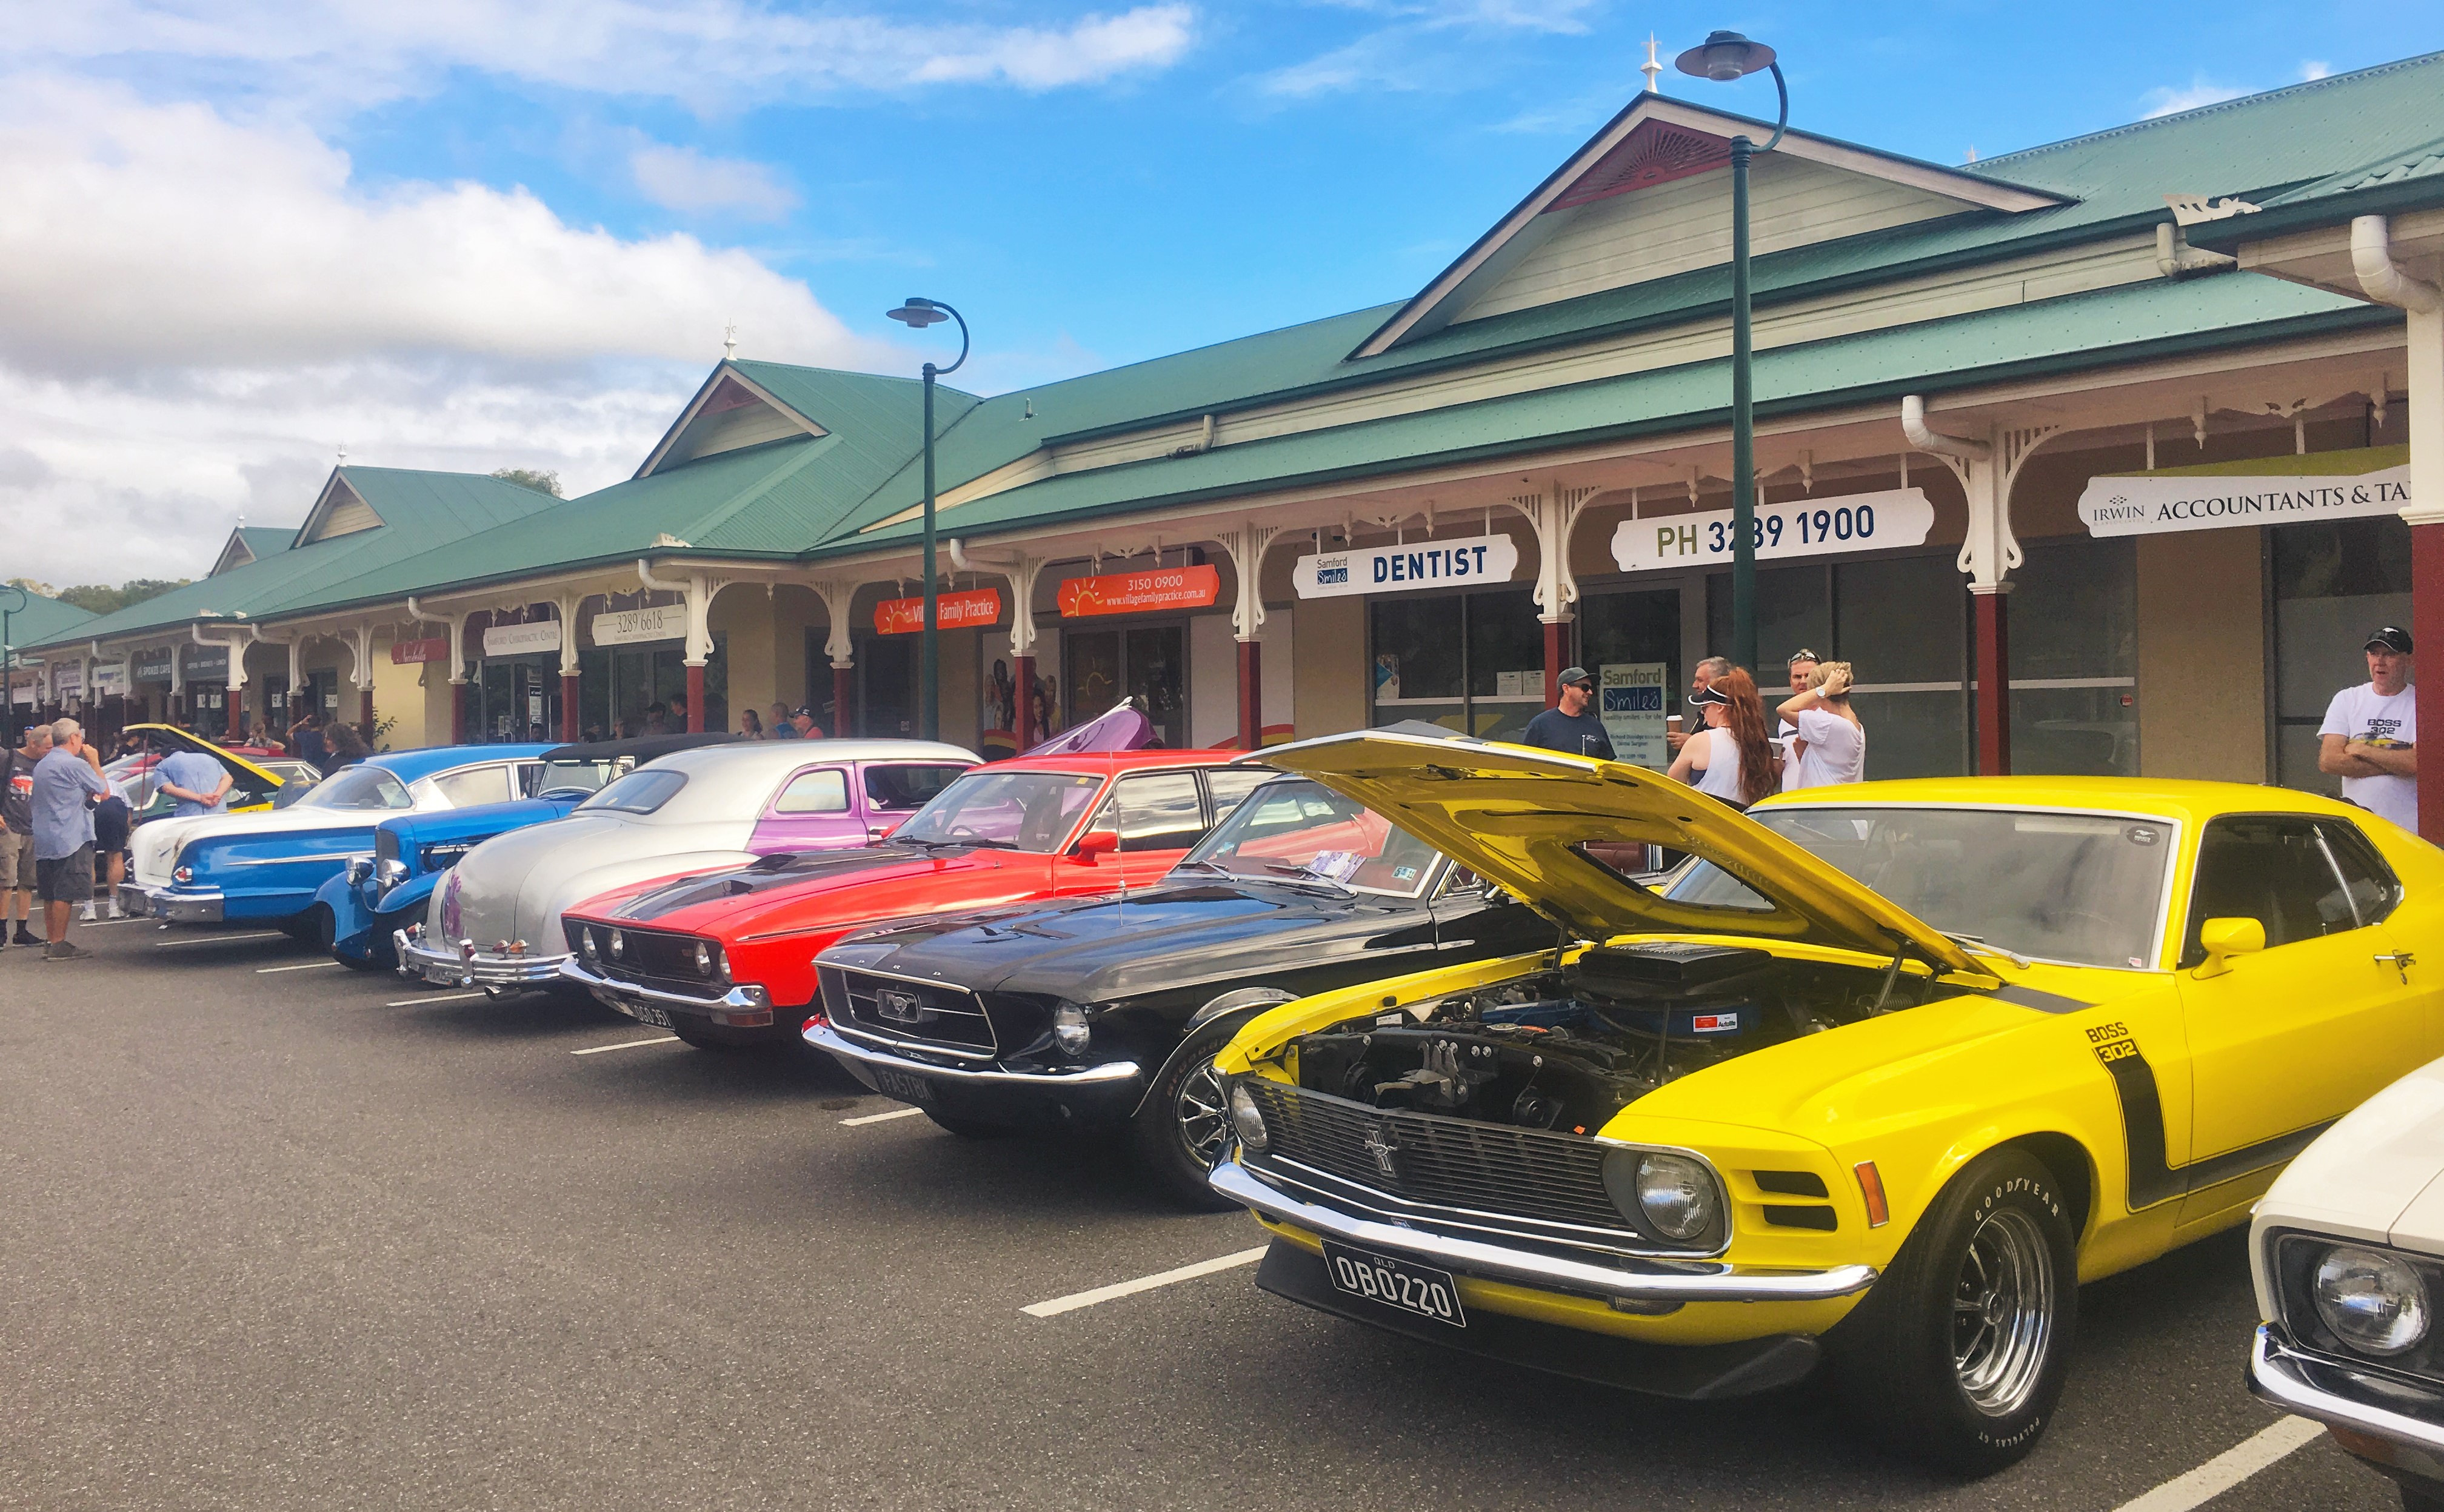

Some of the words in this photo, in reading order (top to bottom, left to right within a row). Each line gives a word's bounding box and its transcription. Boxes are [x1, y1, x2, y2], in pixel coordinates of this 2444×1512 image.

[2157, 487, 2345, 521] ACCOUNTANTS
[2351, 485, 2372, 504] &
[2374, 481, 2411, 502] TA
[2094, 505, 2145, 521] IRWIN
[1657, 524, 1697, 557] PH
[1797, 504, 1875, 545] 1900
[1317, 556, 1347, 569] Samford
[1374, 545, 1487, 584] DENTIST
[1127, 578, 1152, 591] 3150
[1155, 574, 1183, 588] 0900
[1106, 588, 1206, 605] www.villagefamilypractice.com.au
[940, 602, 964, 622] Family
[965, 598, 994, 618] Practice
[617, 613, 638, 634] 3289
[641, 610, 663, 631] 6618
[1603, 668, 1661, 685] Samford
[2367, 718, 2402, 727] BOSS
[2085, 1021, 2129, 1043] BOSS
[2099, 1041, 2137, 1062] 302
[1975, 1177, 2058, 1221] GOODYEAR
[1373, 1257, 1395, 1269] QLD
